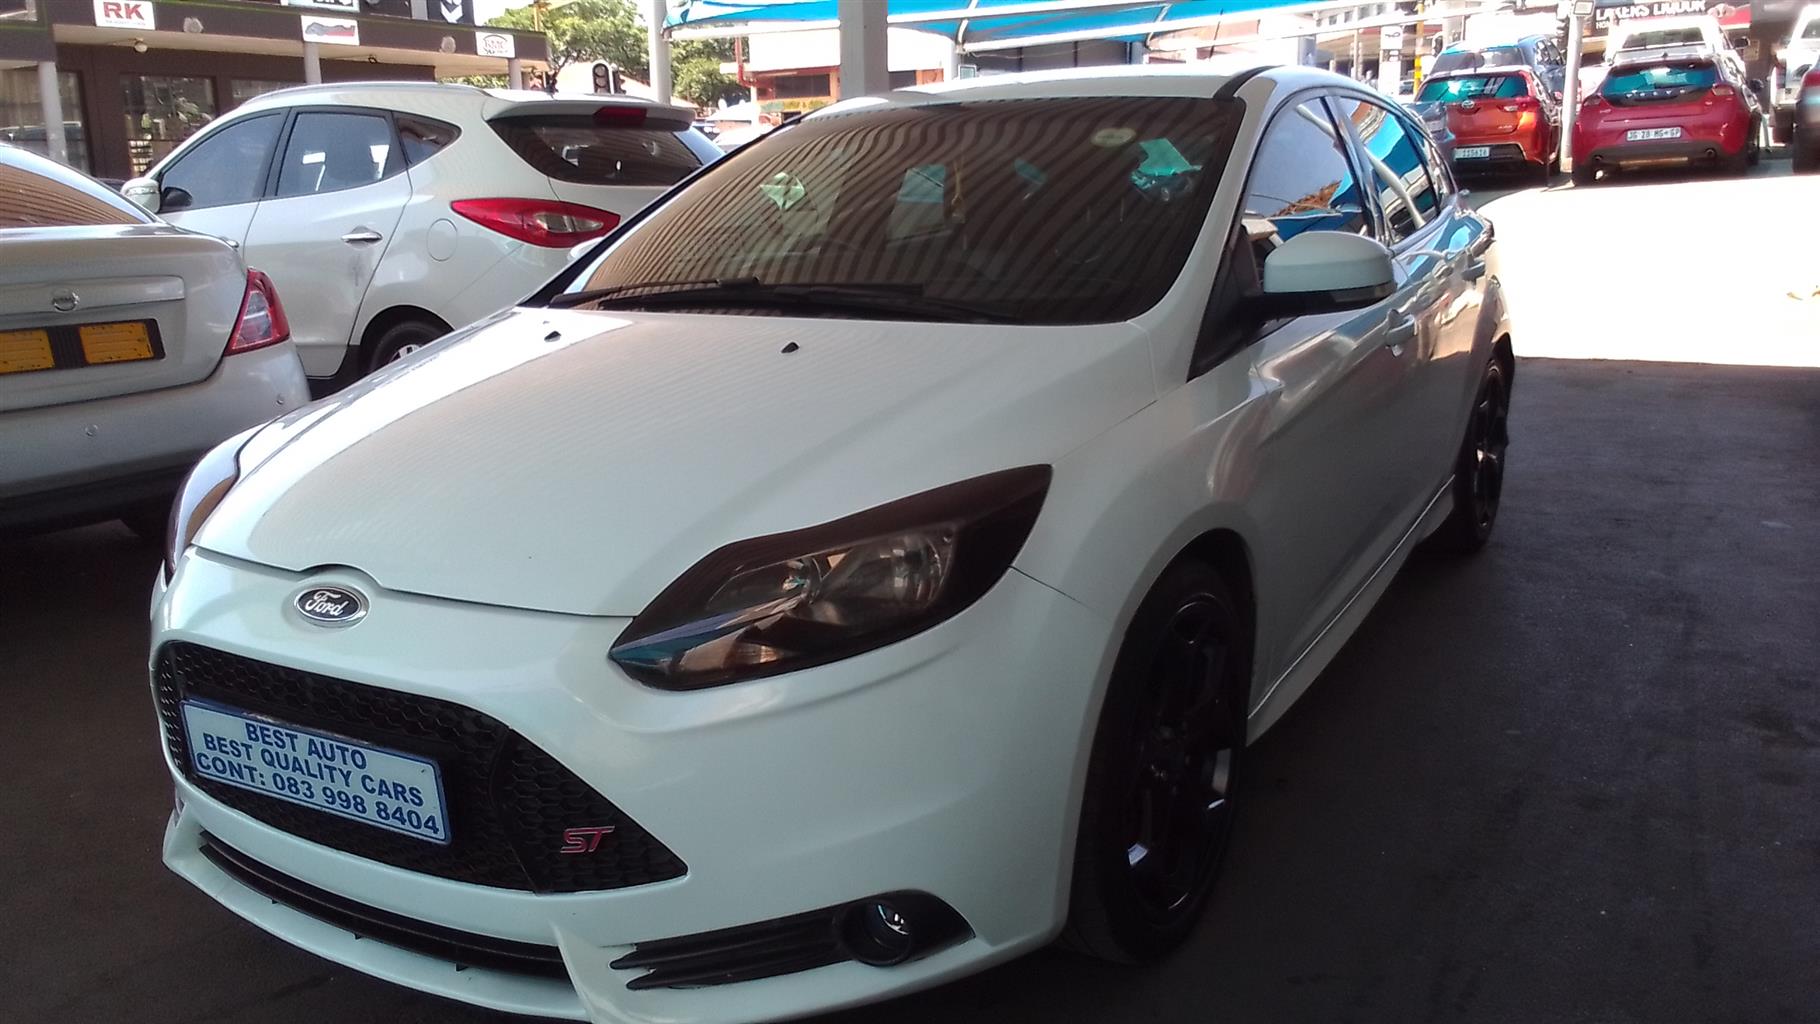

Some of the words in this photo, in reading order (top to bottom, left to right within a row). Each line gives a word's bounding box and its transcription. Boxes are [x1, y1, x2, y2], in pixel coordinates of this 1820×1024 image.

[103, 2, 144, 20] RK
[305, 590, 349, 616] Ford
[245, 722, 298, 752] BEST
[308, 738, 367, 770] AUTO
[203, 732, 253, 761] BEST
[261, 748, 352, 788] QUALITY
[361, 774, 424, 807] CARS
[196, 752, 267, 787] CONT:
[272, 772, 315, 800] 083
[322, 786, 367, 814] 998
[375, 801, 440, 835] 8404
[560, 825, 615, 854] ST
